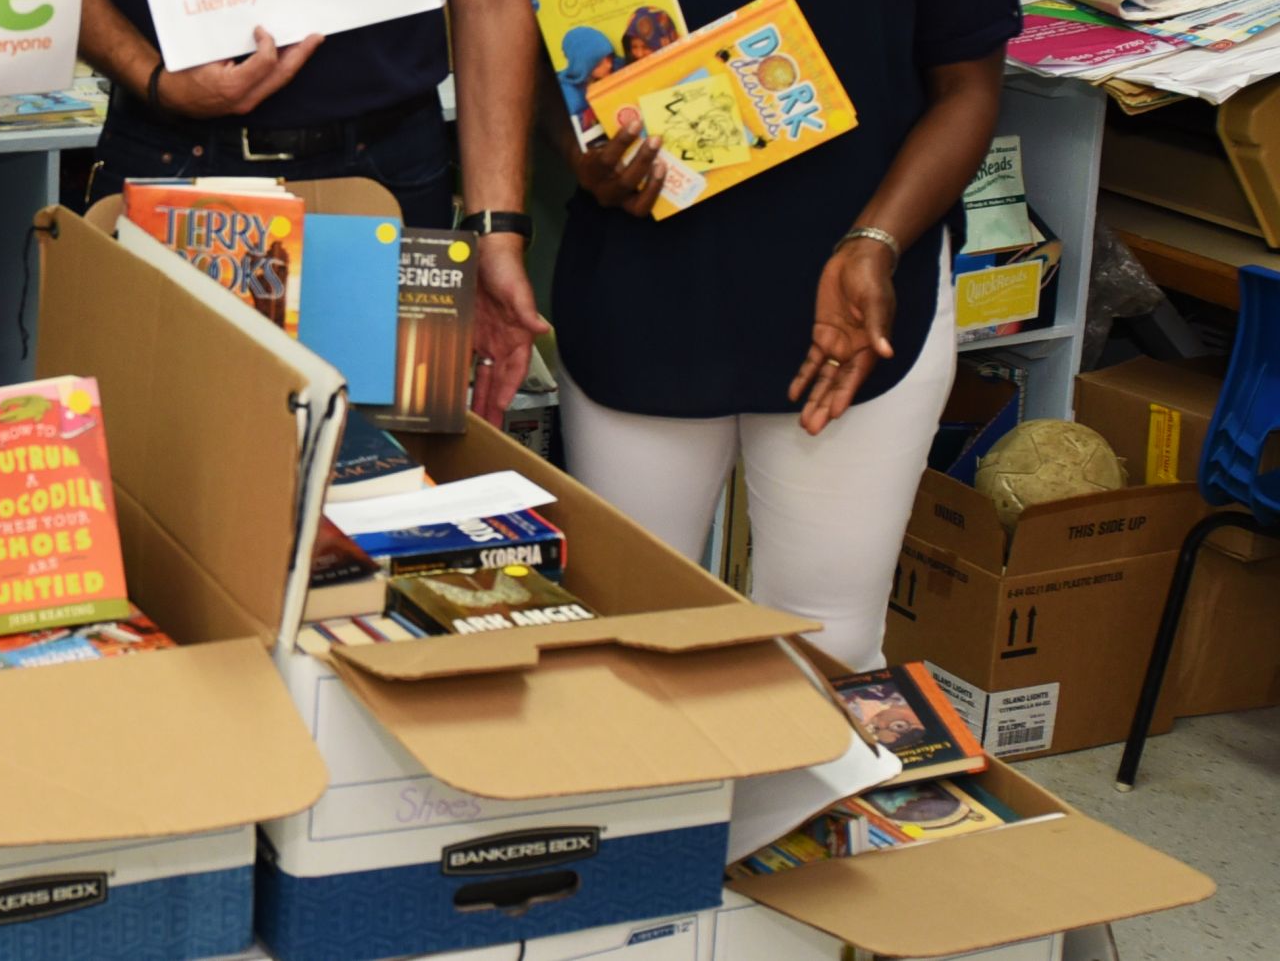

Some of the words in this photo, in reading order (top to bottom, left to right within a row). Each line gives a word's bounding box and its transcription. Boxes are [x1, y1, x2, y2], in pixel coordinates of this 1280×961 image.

[737, 23, 824, 141] DORK
[729, 57, 780, 140] diaries
[155, 206, 272, 256] TERRY
[413, 252, 438, 268] THE
[175, 249, 291, 300] OOKS
[37, 423, 57, 438] TO
[26, 474, 39, 489] A
[41, 510, 92, 529] YOUR
[1068, 523, 1096, 540] THIS
[1098, 518, 1126, 537] SIDE
[1128, 516, 1147, 533] UP
[27, 557, 59, 576] ARE
[479, 544, 543, 568] SCORPIA
[38, 604, 97, 623] KEATING
[452, 611, 513, 636] ARK
[510, 603, 595, 628] ANGEL
[395, 787, 483, 825] Shoes
[450, 842, 547, 868] BANKERS
[548, 834, 592, 854] BOX
[52, 881, 99, 902] BOX
